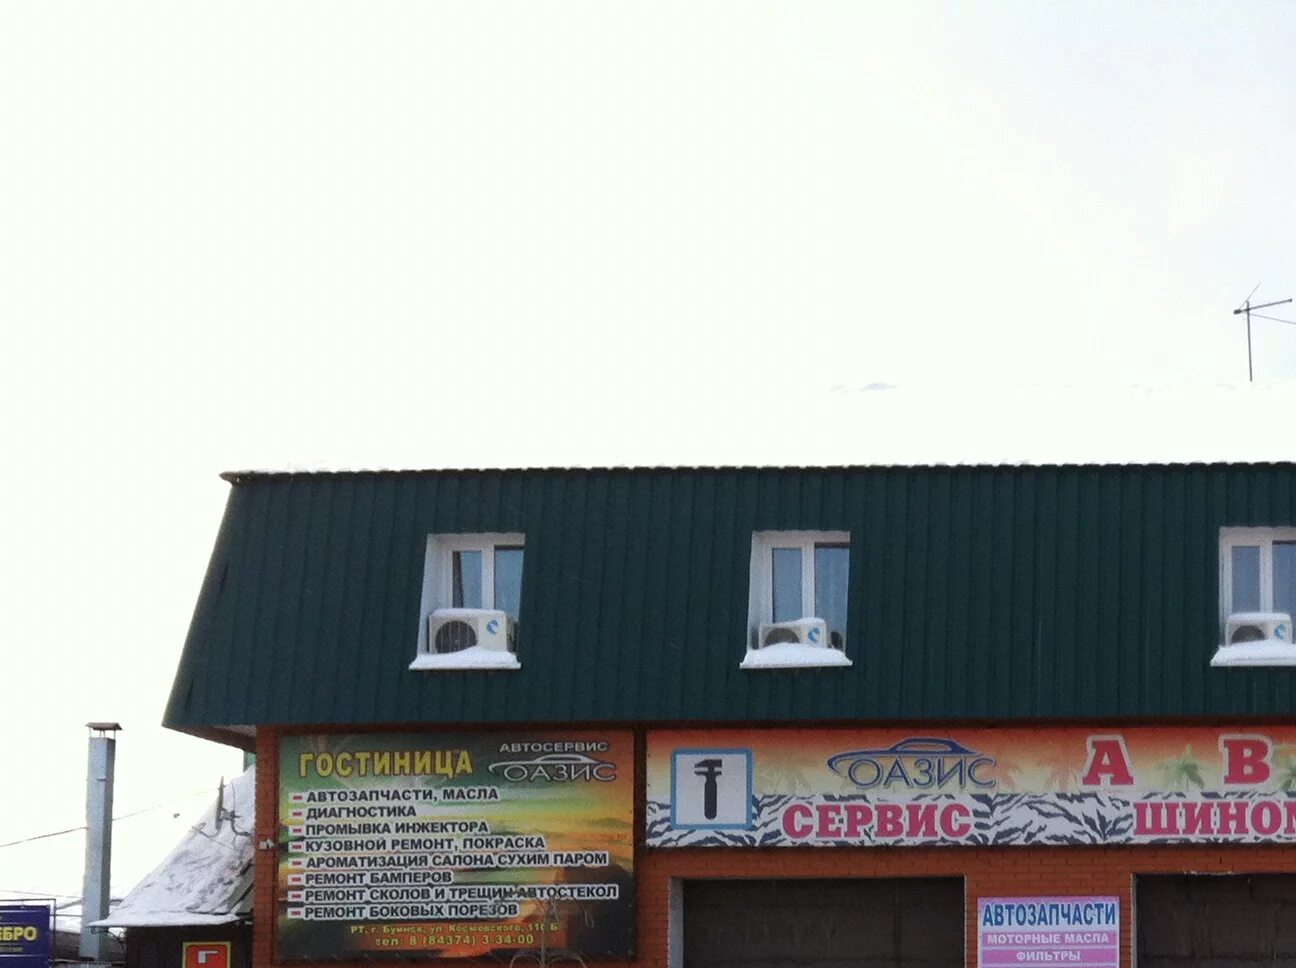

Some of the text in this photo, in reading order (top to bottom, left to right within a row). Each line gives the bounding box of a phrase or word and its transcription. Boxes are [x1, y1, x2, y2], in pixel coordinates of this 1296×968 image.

[500, 741, 609, 753] АВТОСЕРВИС
[300, 750, 473, 778] ГОСТИНИЦА
[503, 763, 616, 781] ОАЗИС
[846, 756, 996, 790] ОАЗИС
[306, 787, 498, 802] АВТОЗАПЧАСТИ, МАСЛА
[306, 805, 417, 820] ДИАГНОСТИКА
[305, 821, 489, 836] ПРОМЫВКА ИНЖЕКТОРА
[782, 803, 974, 839] СЕРВИС
[305, 836, 545, 852] КУЗОВНОЙ РЕМОНТ, ПОКРАСКА
[306, 852, 608, 869] АРОМАТИЗАЦИЯ САЛОНА СУХИМ ПАРОМ
[305, 871, 452, 884] РЕМОНТ БАМПЕРОВ
[305, 885, 618, 901] РЕМОНТ СКОЛОВ И ТРЕЩИН АВТОСТЕКОЛ
[305, 904, 518, 919] РЕМОНТ БОКОВЫХ ПОРЕЗОВ
[982, 903, 1116, 926] АВТОЗАПЧАСТИ
[409, 935, 417, 945] 8
[482, 934, 534, 945] 3-34-00
[987, 932, 1110, 944] МОТОРНЫЕ МАСЛА
[1016, 950, 1081, 961] ФИЛЬТРЫ
